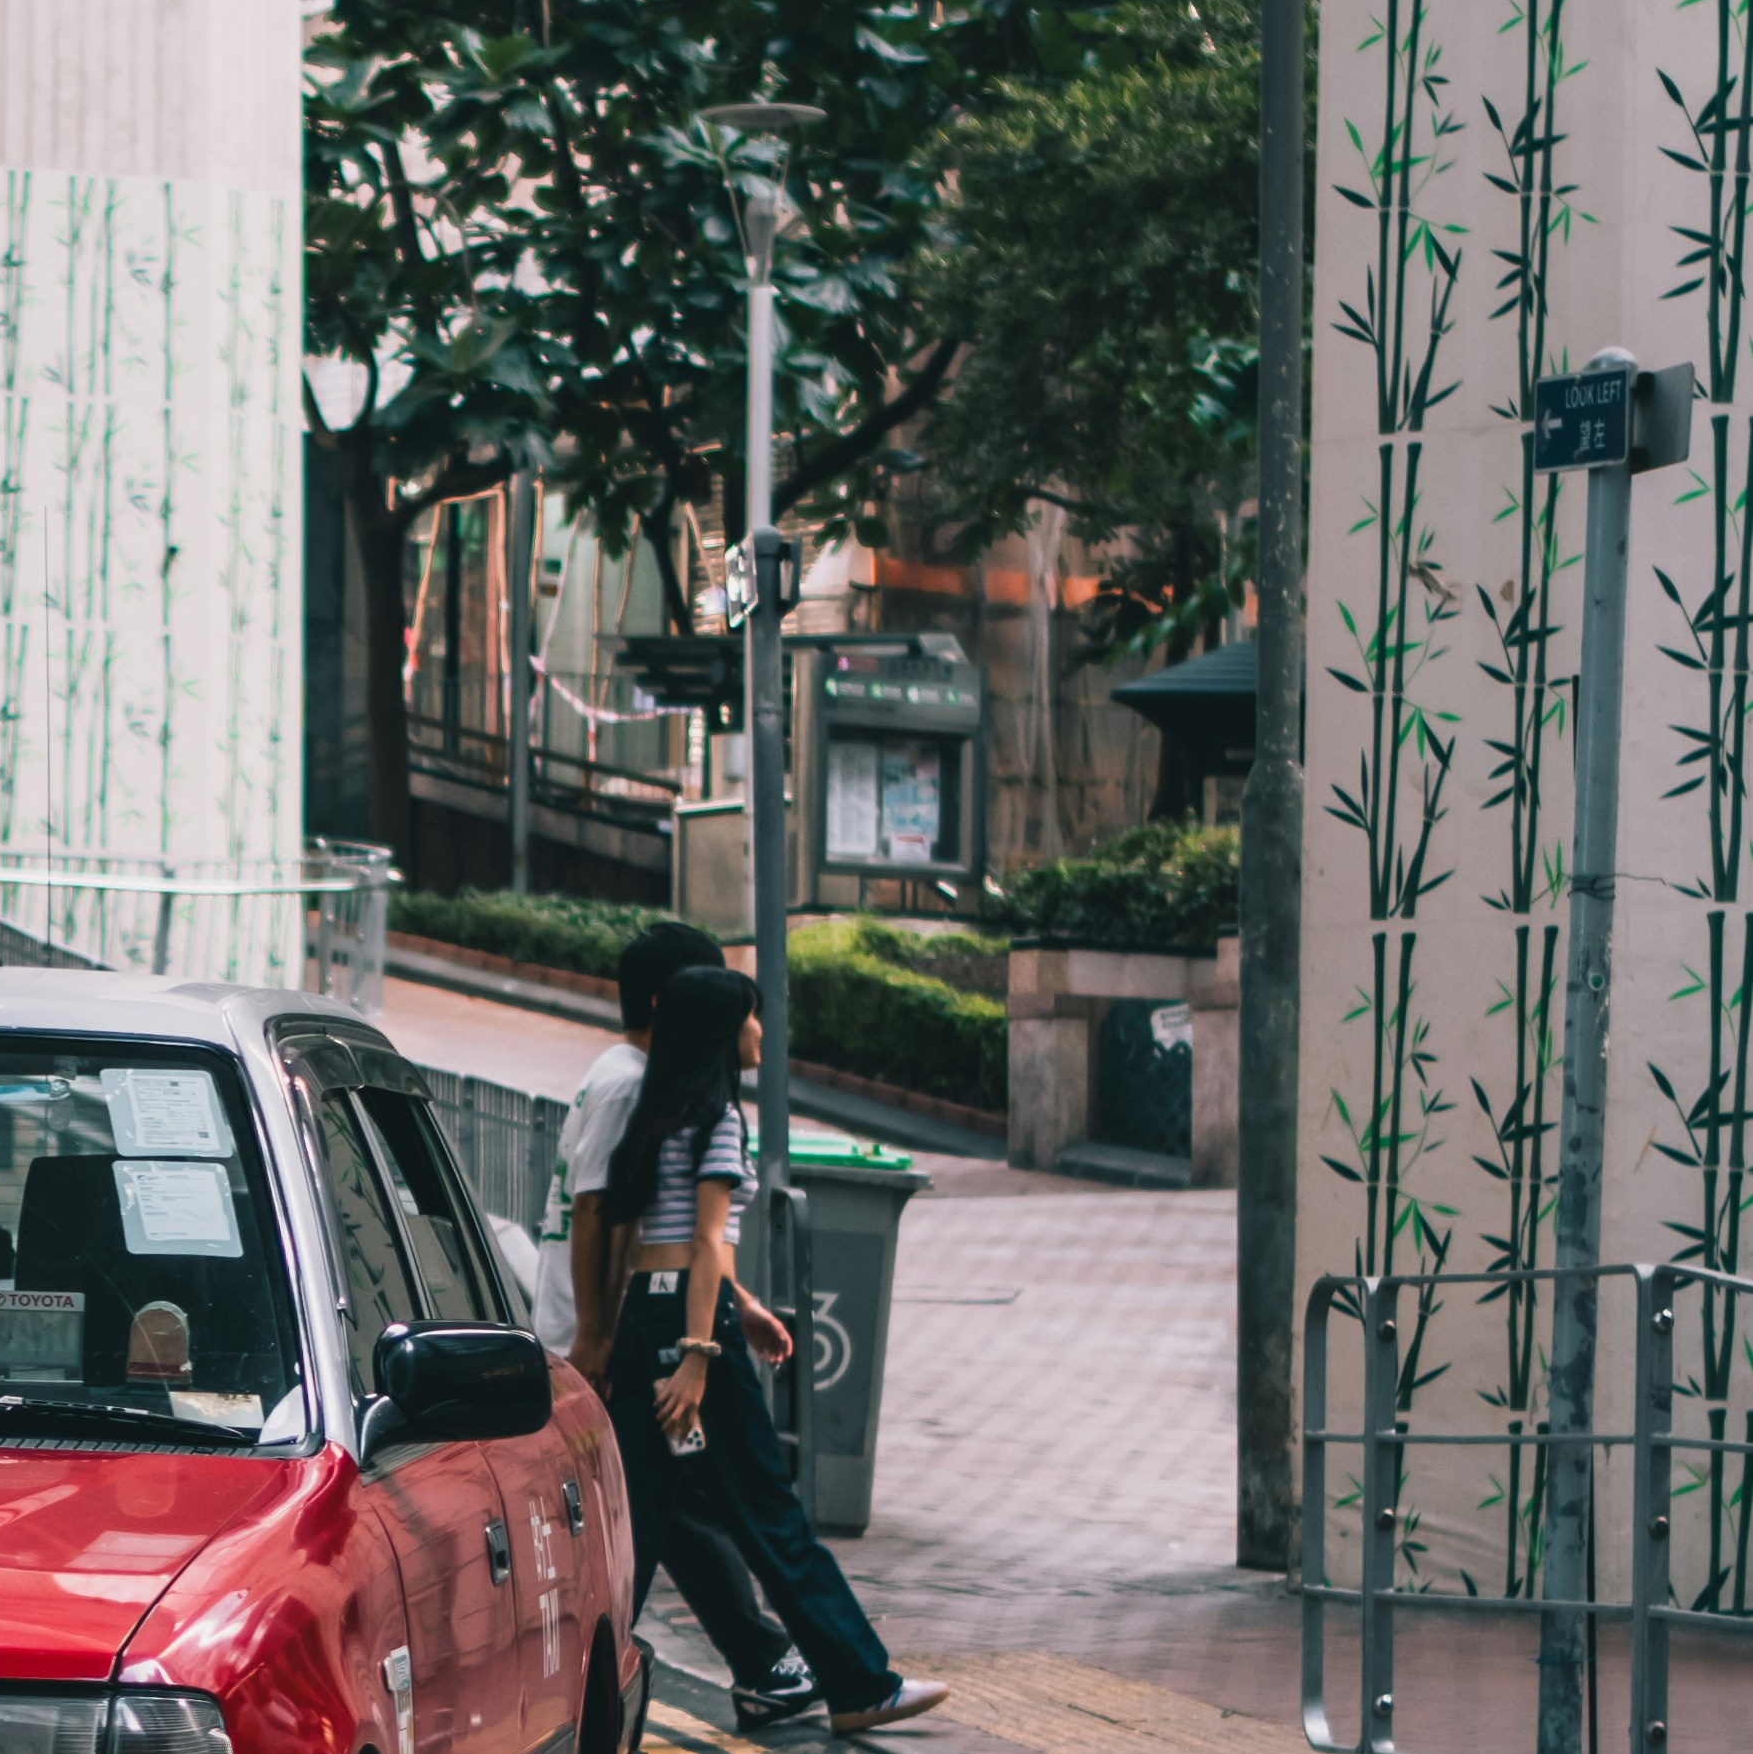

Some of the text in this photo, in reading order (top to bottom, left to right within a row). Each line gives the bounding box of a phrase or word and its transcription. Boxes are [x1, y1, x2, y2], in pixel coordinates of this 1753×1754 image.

[1565, 379, 1622, 409] LOOK LEFT
[8, 1293, 75, 1309] TOYOTA
[528, 1495, 557, 1583] 的士
[538, 1587, 561, 1679] TAXI
